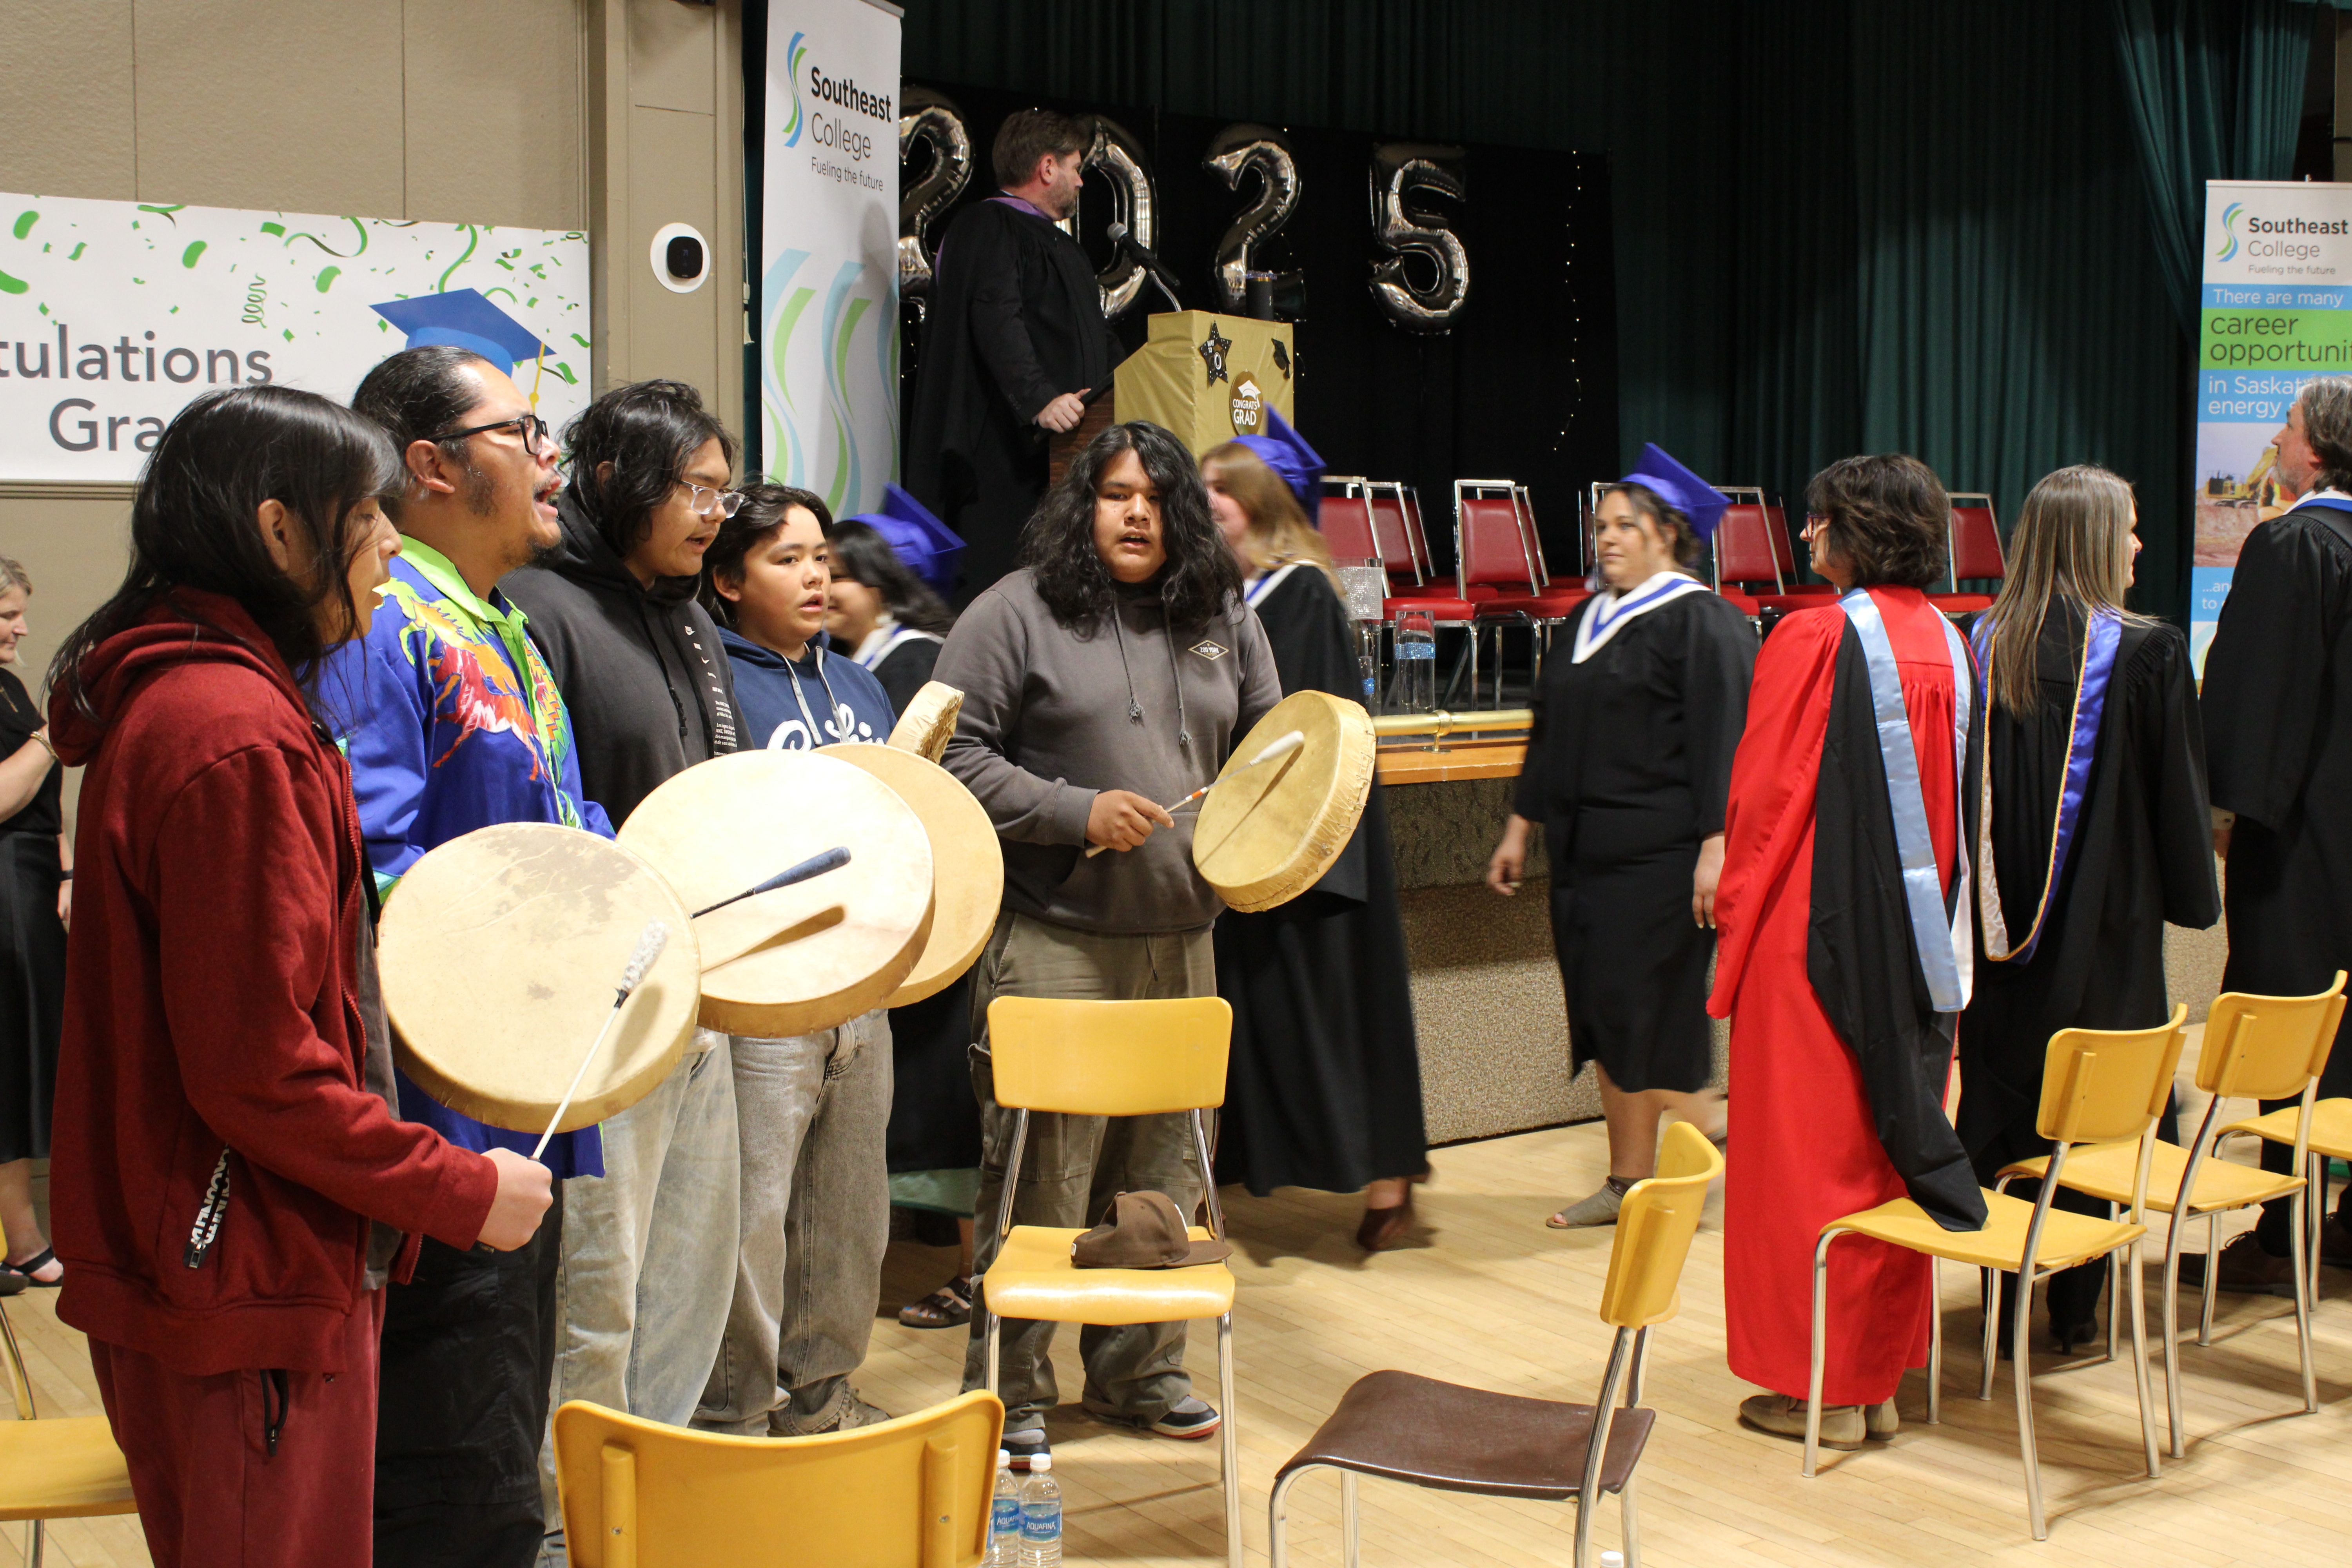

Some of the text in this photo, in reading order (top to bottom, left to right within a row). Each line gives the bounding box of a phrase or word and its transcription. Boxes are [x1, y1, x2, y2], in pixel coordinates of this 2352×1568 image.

[811, 67, 891, 123] Southeast
[812, 113, 871, 161] College
[812, 156, 883, 191] Fueling the future
[2249, 218, 2348, 234] Southeast
[2248, 240, 2320, 260] College
[2248, 264, 2336, 275] Fueling the future
[2213, 289, 2344, 308] There are many
[2210, 317, 2299, 335] career
[2210, 339, 2352, 366] opportuni
[2209, 376, 2305, 394] in Saskat
[1233, 398, 1258, 410] CONGRATS
[2209, 400, 2282, 419] energy
[1234, 408, 1257, 426] GRAD
[2202, 598, 2218, 609] to
[1027, 1522, 1056, 1530] AQUAFINA
